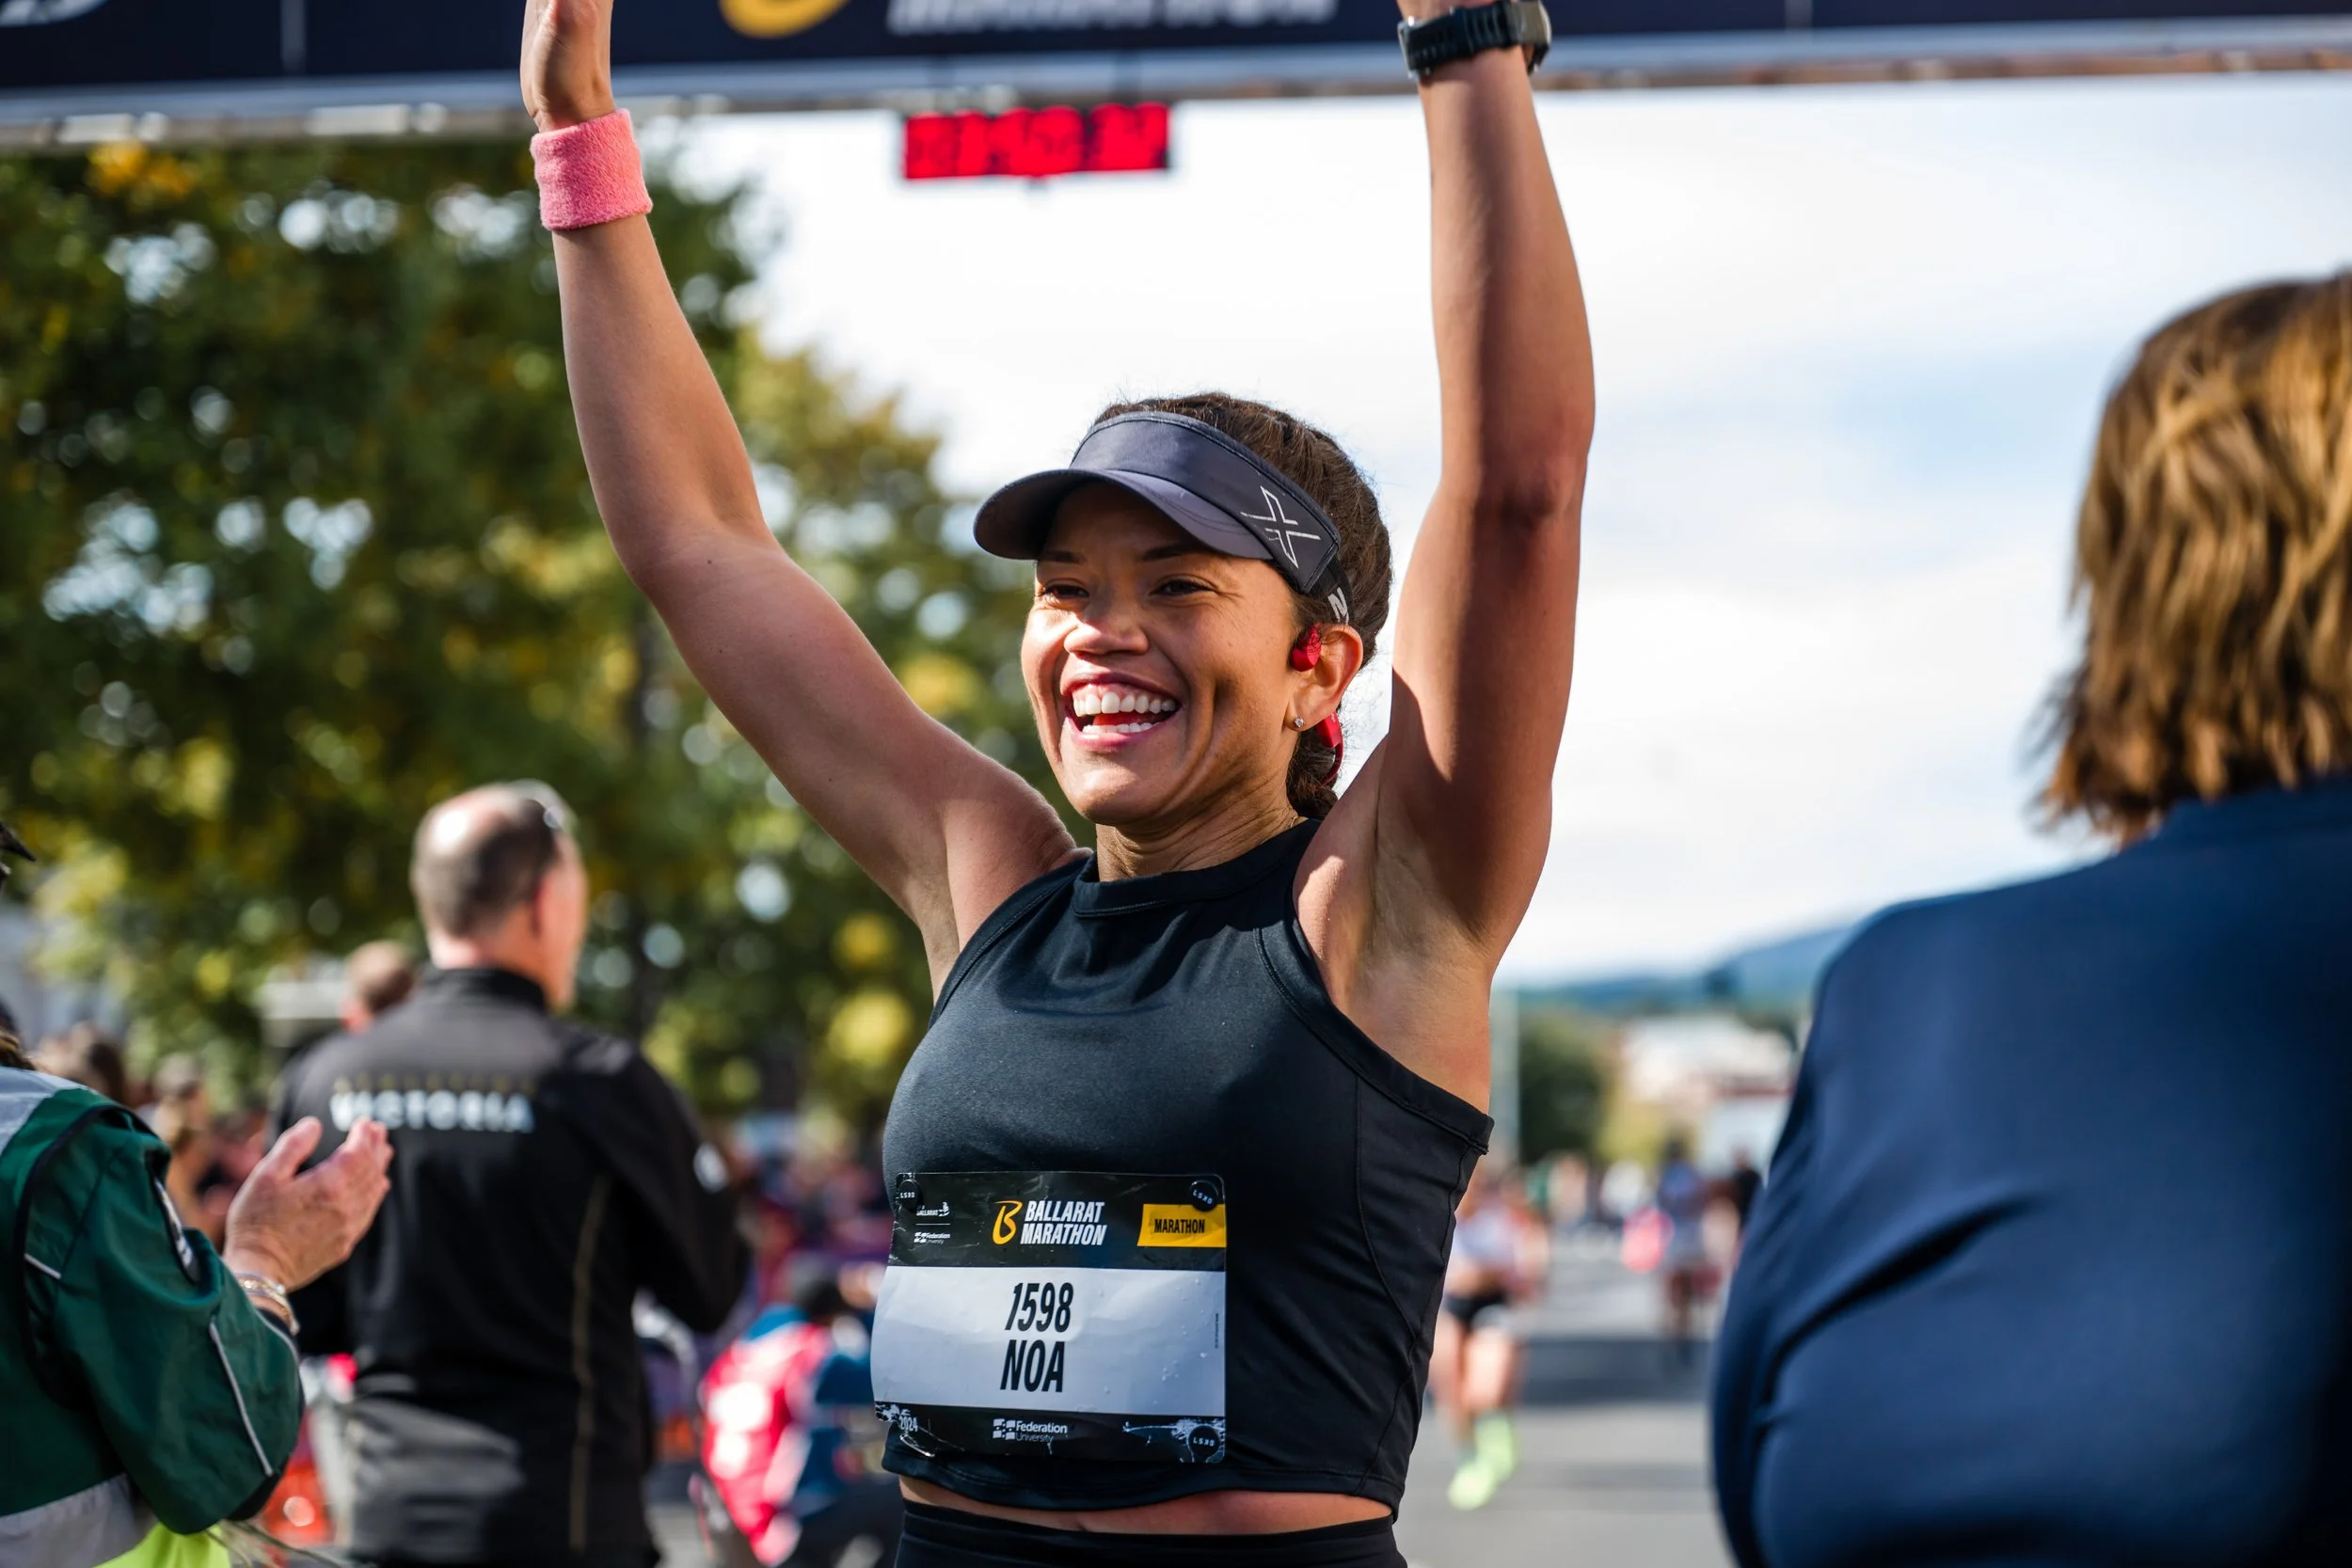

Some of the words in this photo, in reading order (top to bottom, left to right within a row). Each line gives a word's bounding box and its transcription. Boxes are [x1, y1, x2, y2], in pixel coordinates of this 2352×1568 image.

[1025, 1200, 1104, 1223] BALLARAT
[1020, 1223, 1107, 1245] MARATHON
[1154, 1219, 1205, 1233] MARATHON
[1005, 1282, 1073, 1332] 1598
[1000, 1339, 1065, 1392] NOA
[1016, 1420, 1067, 1433] Federation
